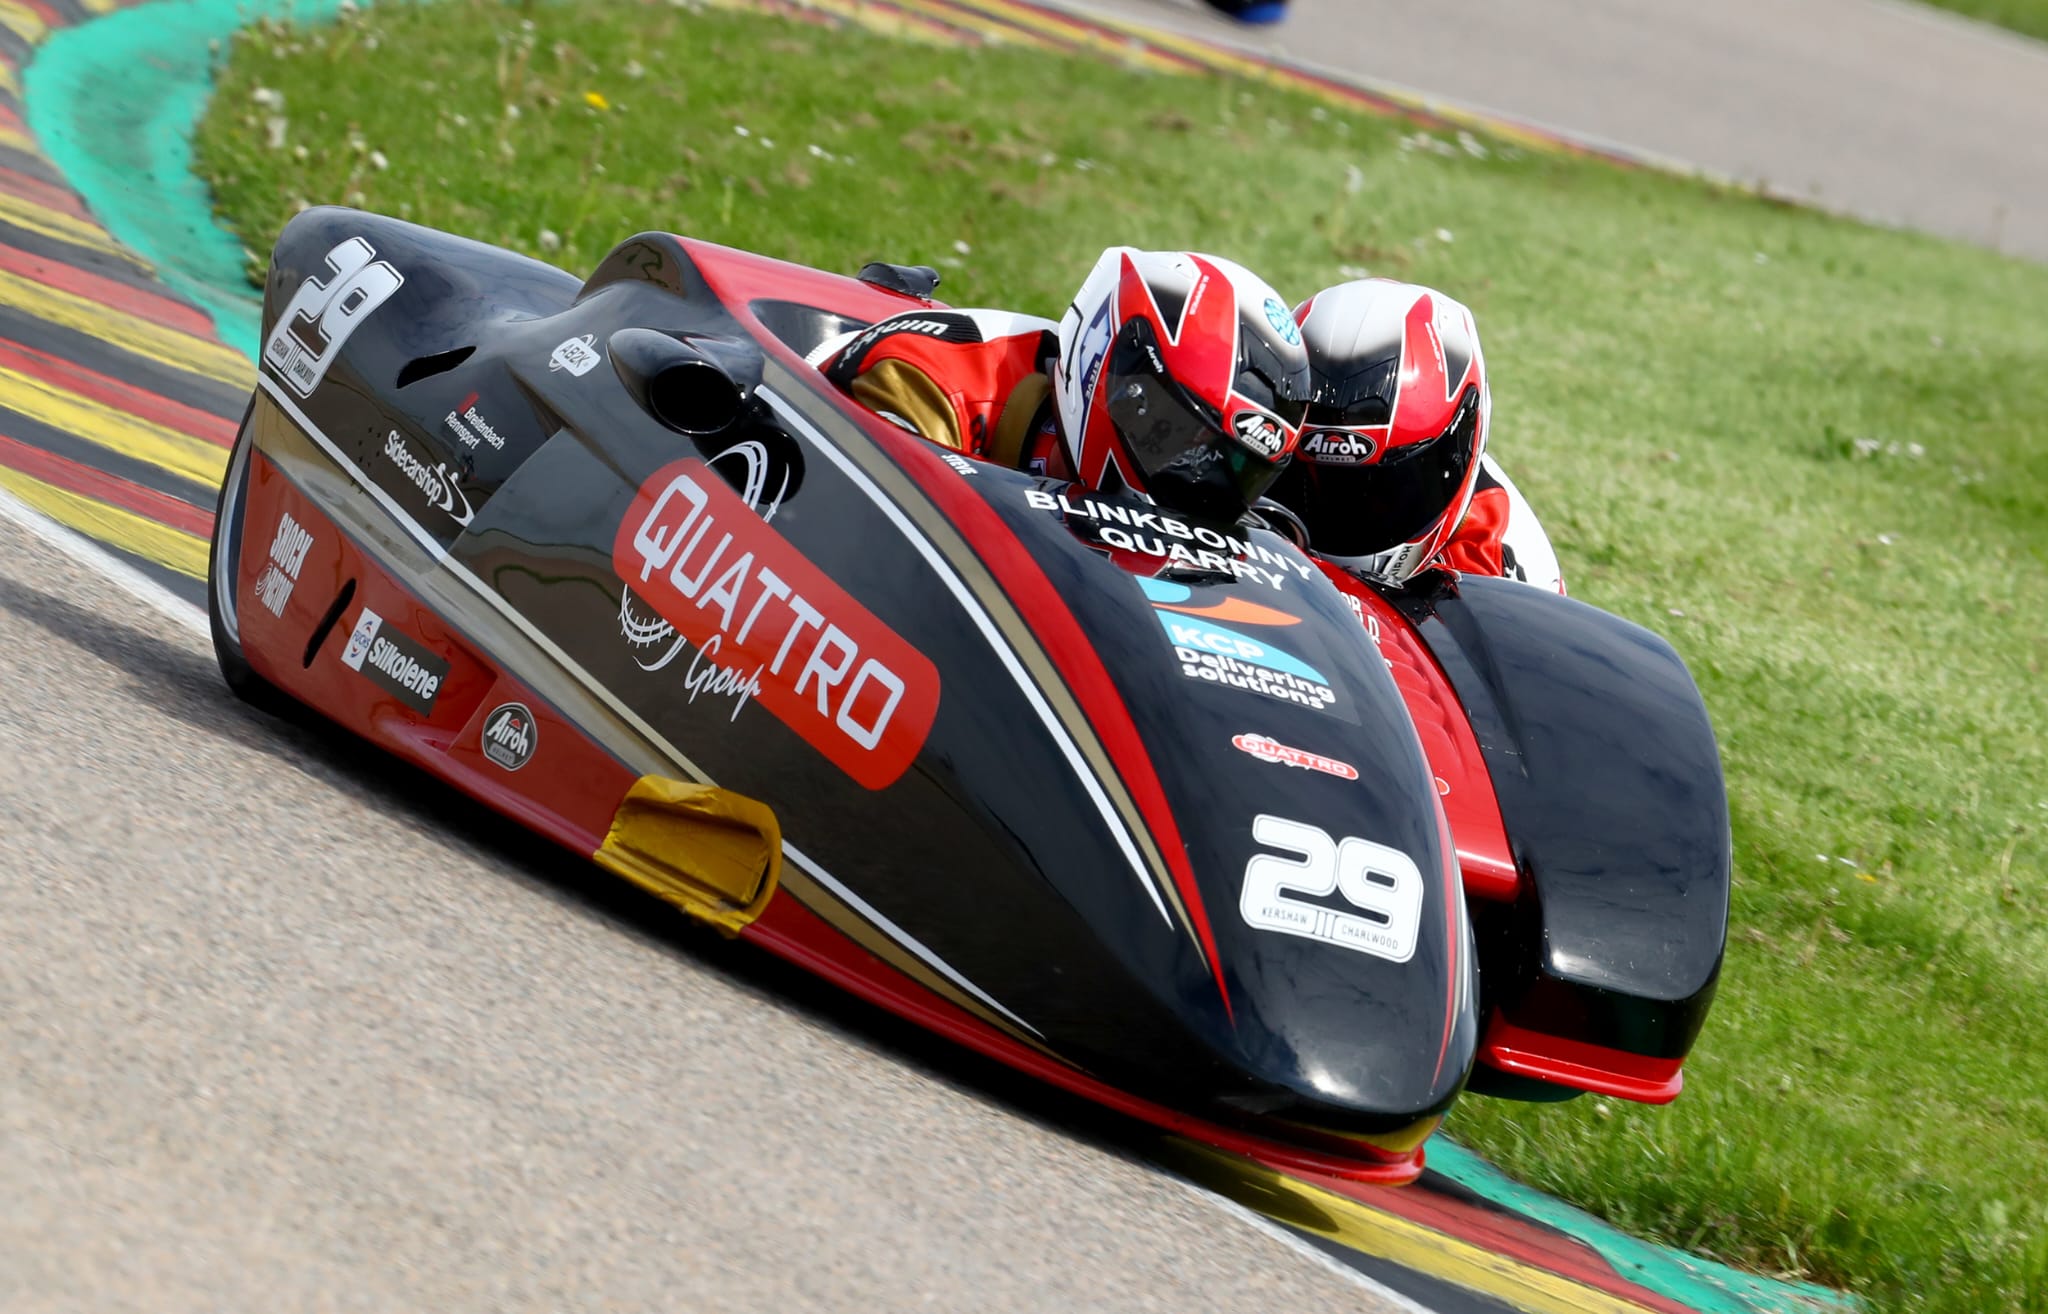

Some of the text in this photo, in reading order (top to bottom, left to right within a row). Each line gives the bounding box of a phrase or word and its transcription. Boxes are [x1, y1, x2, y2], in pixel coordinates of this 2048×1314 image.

[264, 237, 405, 398] 29
[444, 410, 481, 449] Rennsport
[464, 406, 505, 451] Breitenbach
[1237, 415, 1283, 453] Airoh
[1304, 433, 1367, 455] Airoh
[385, 430, 442, 507] Sidecarshop
[270, 512, 315, 580] SHOCK
[1024, 490, 1311, 580] BLINKBONNY
[1099, 527, 1285, 591] QUARRY
[633, 475, 905, 751] QUATTRO
[1170, 624, 1264, 658] KCP
[368, 637, 438, 699] Silkolene
[684, 634, 762, 722] Group
[1174, 646, 1336, 703] Delivering
[1182, 664, 1325, 709] solutions
[486, 711, 529, 756] Airoh
[1241, 739, 1348, 775] QUATTRO
[1240, 814, 1424, 963] 29
[1262, 906, 1399, 950] KERSHAW CHARLWOOD
